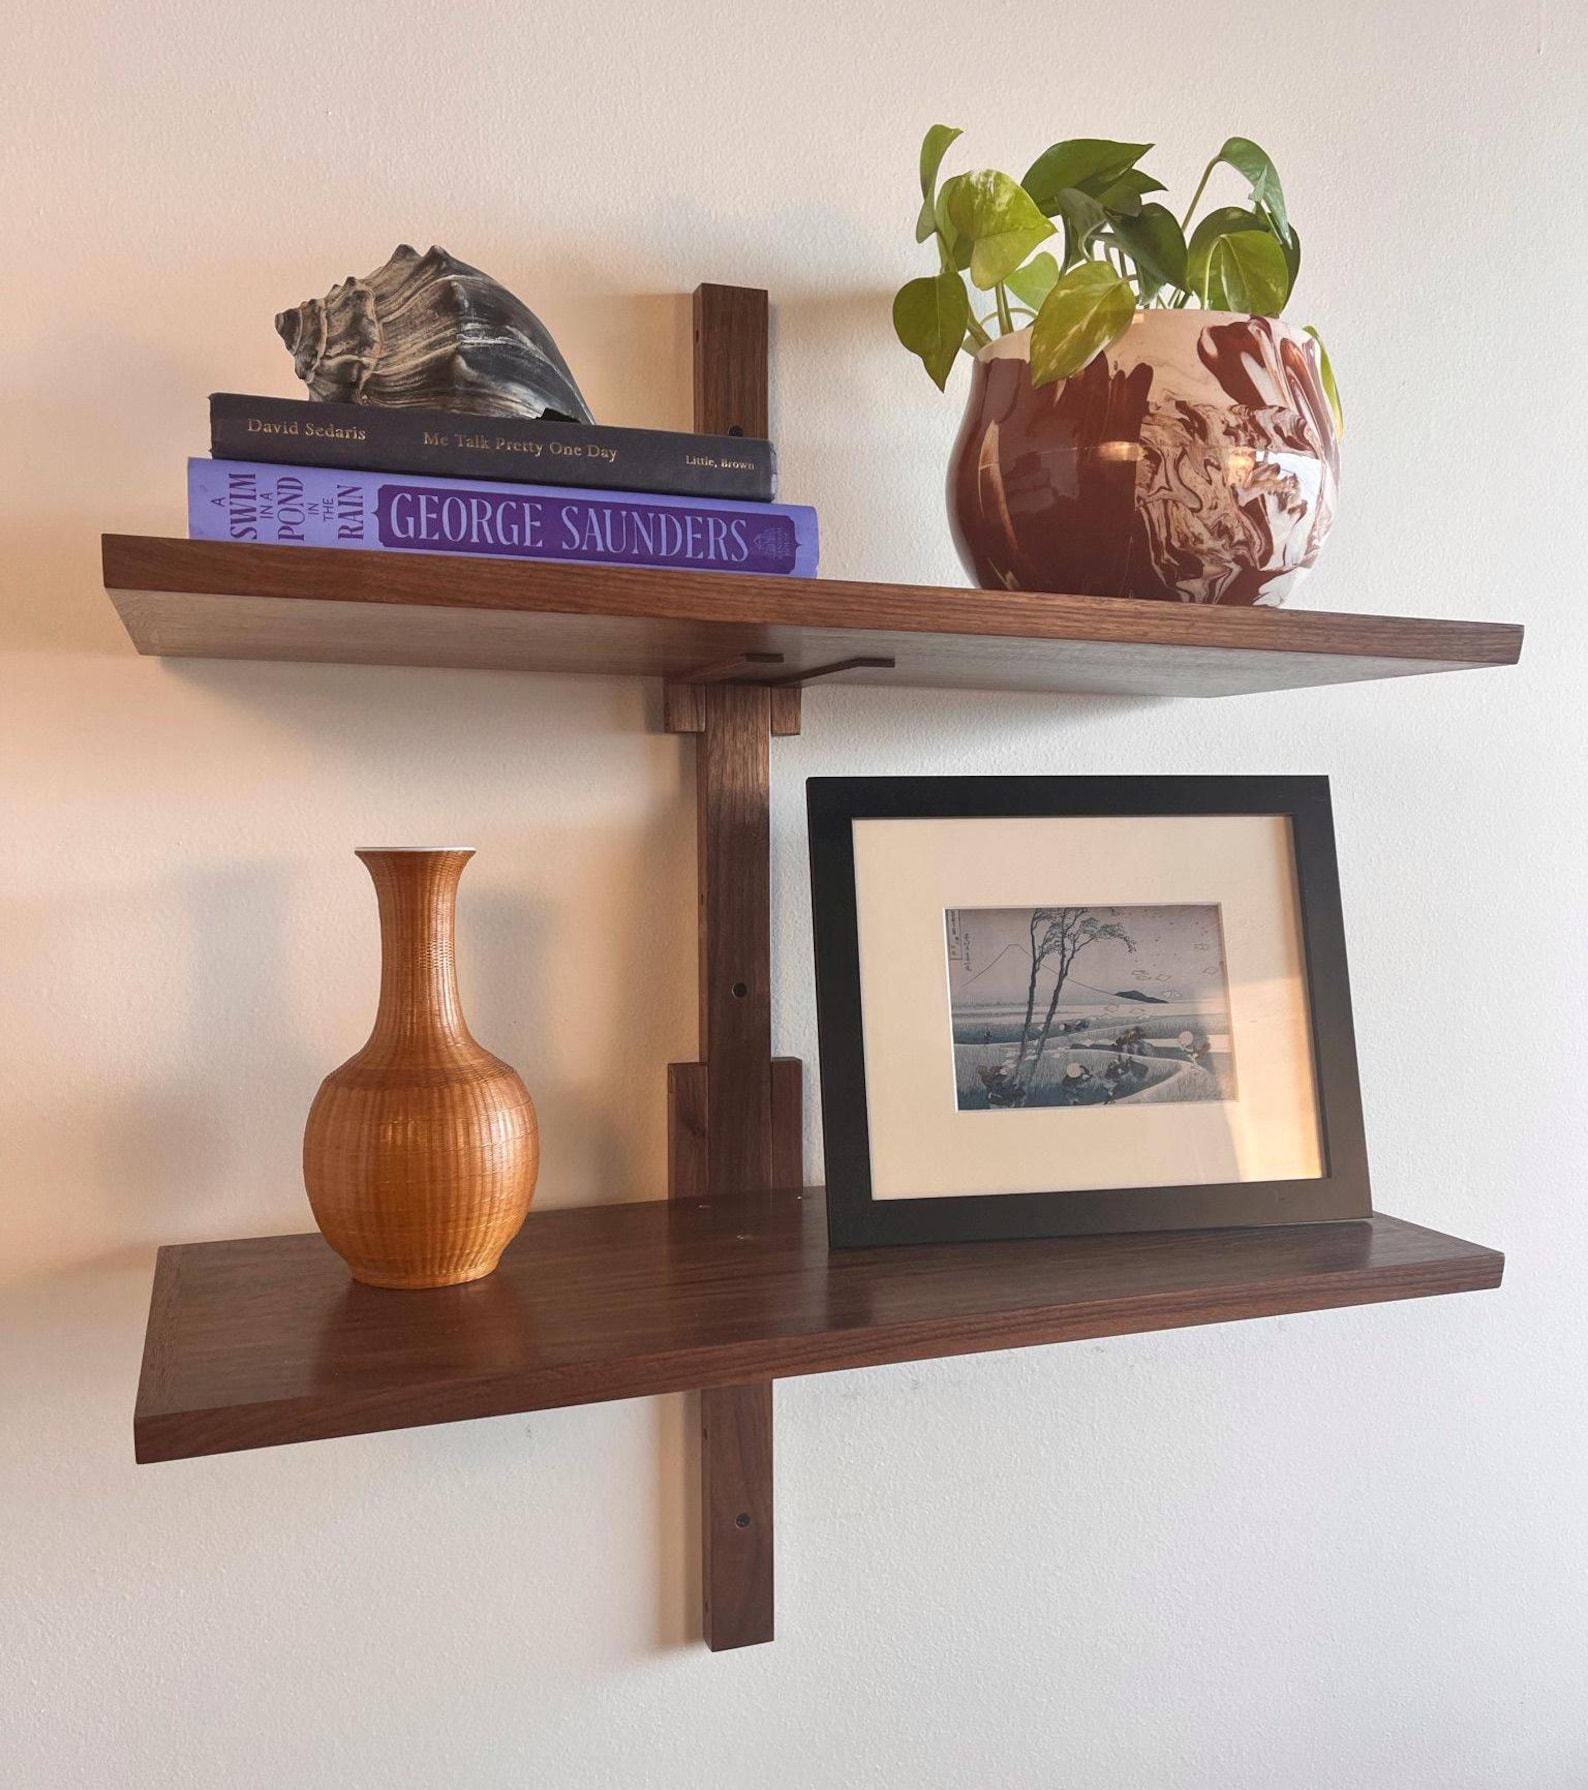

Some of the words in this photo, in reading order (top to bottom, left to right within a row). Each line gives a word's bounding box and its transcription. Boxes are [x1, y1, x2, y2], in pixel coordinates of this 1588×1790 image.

[247, 418, 298, 436] David
[305, 423, 367, 441] Sedaris
[423, 432, 448, 446] Me
[454, 433, 490, 449] Talk
[496, 438, 543, 457] Pretty
[549, 442, 583, 456] One
[587, 444, 618, 463] Day
[686, 455, 718, 468] Little,
[721, 458, 755, 471] Brown
[210, 496, 226, 508] A
[228, 473, 258, 540] SWIM
[259, 492, 273, 501] A
[276, 476, 305, 541] POND
[308, 502, 320, 515] IN
[259, 505, 274, 519] IN
[322, 497, 334, 522] THE
[337, 484, 364, 541] RAIN
[390, 493, 543, 548] GEORGE
[561, 505, 749, 562] SAUNDERS
